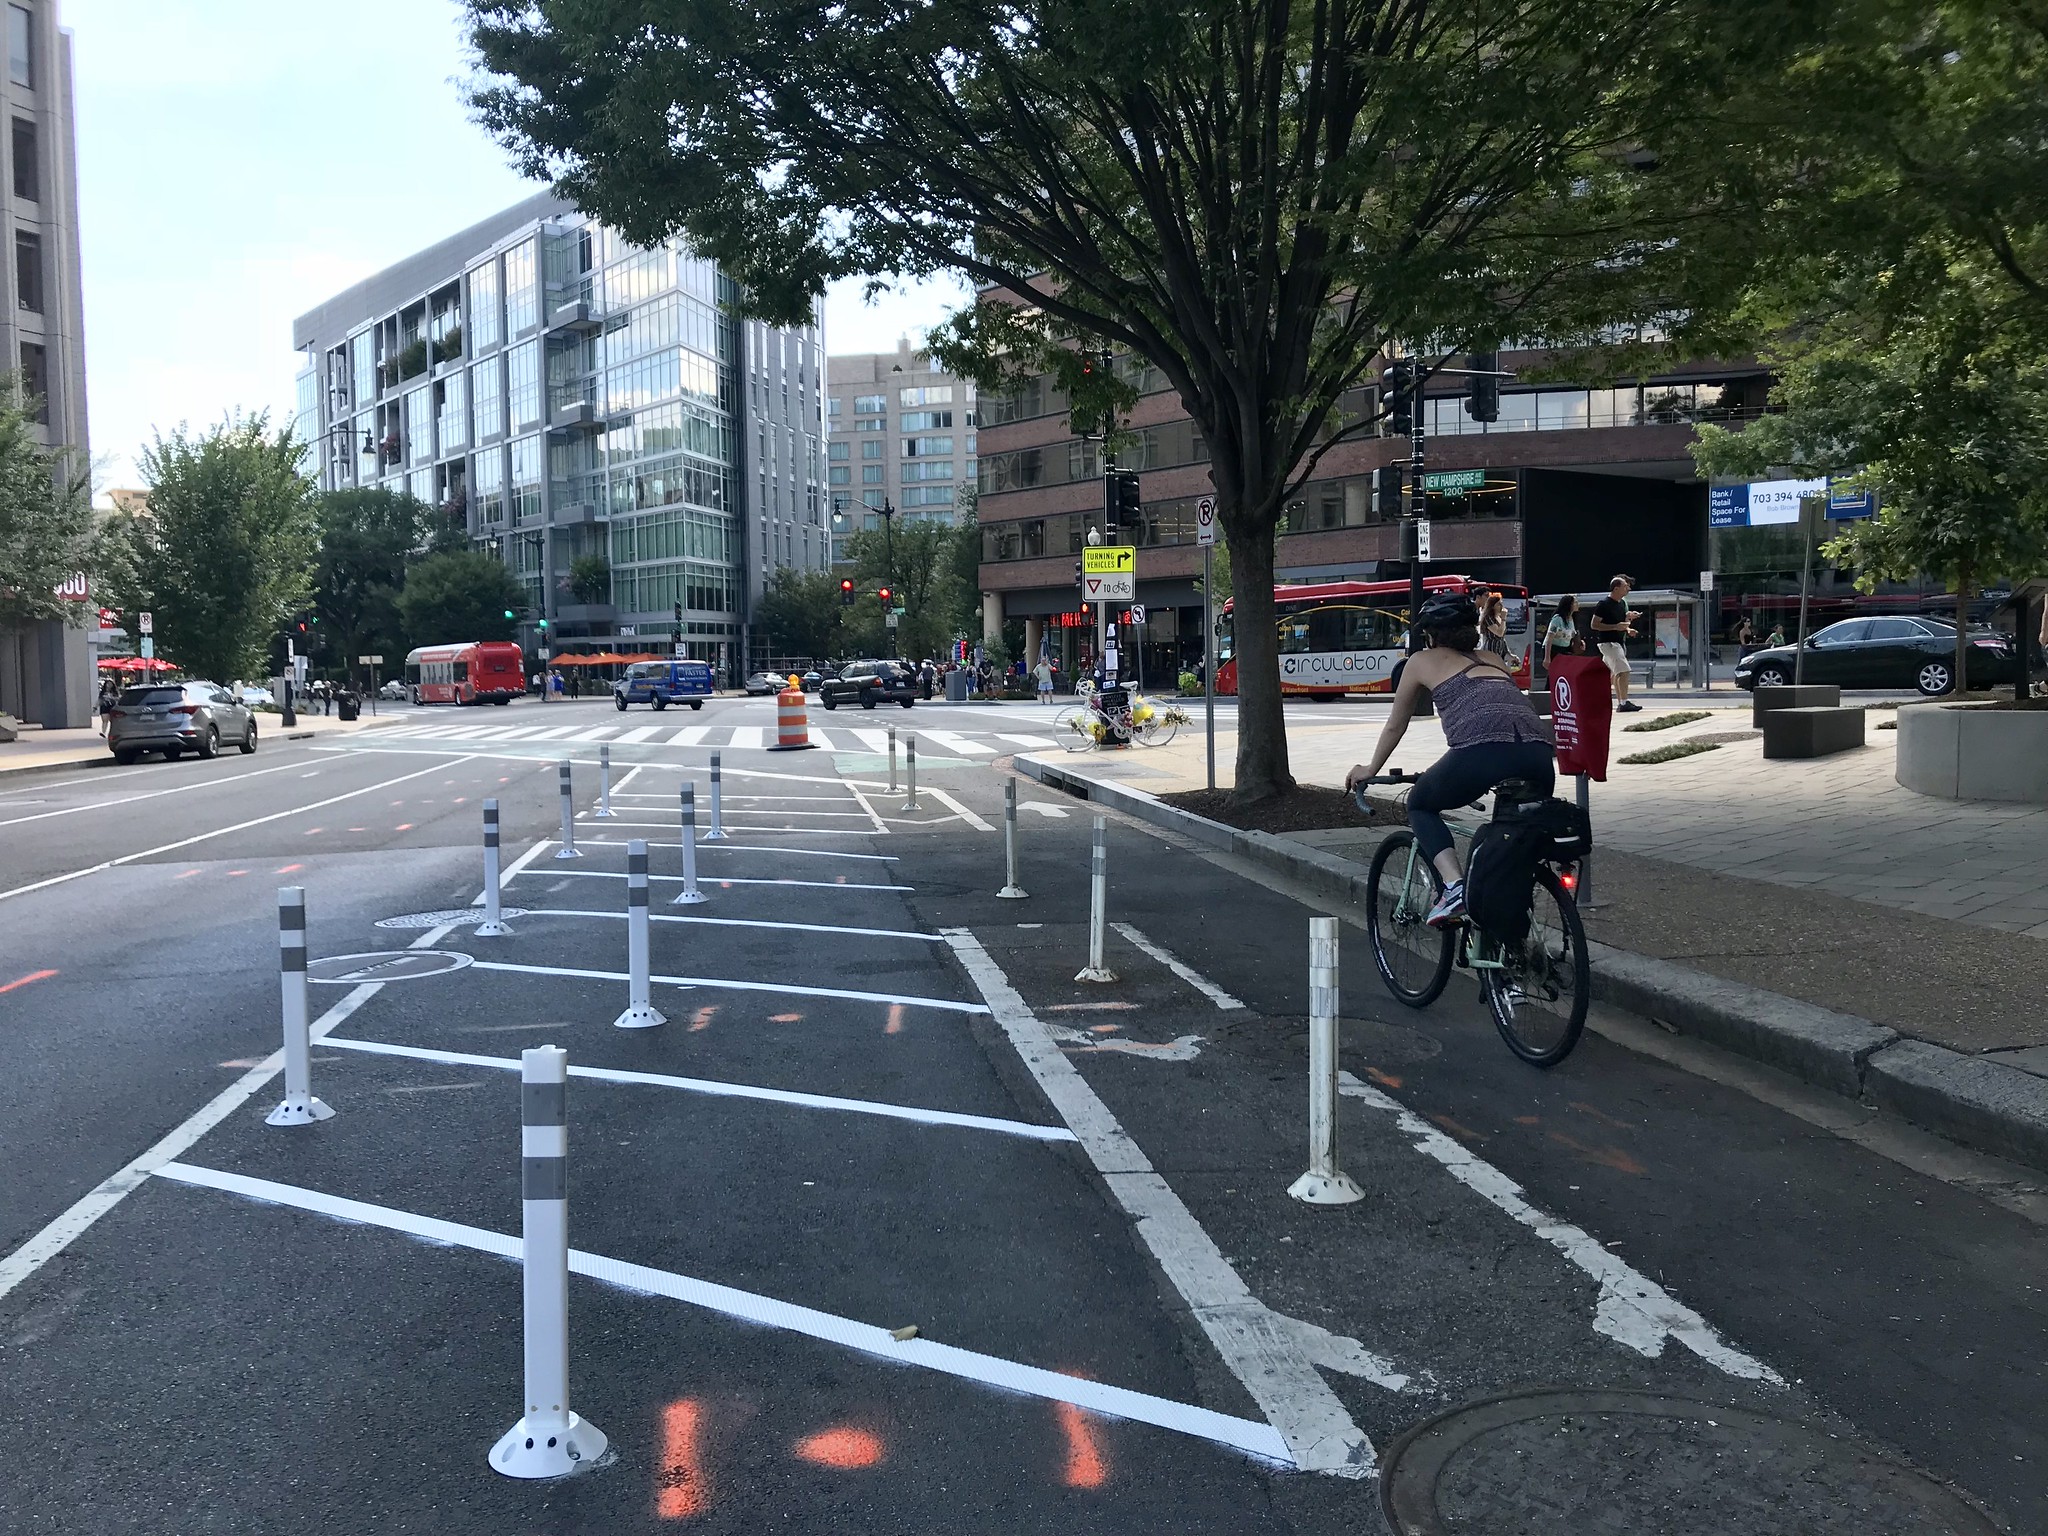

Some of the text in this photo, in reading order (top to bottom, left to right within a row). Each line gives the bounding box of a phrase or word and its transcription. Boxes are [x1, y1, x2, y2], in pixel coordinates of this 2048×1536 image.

[1426, 473, 1474, 488] NEW HAMPSHIRE
[1444, 486, 1463, 497] 1200
[1712, 490, 1729, 498] Bank
[1753, 493, 1771, 504] 703
[1774, 491, 1793, 502] 394
[1712, 499, 1730, 507] Retail
[1711, 507, 1733, 516] Space
[1103, 584, 1111, 593] TO
[1349, 684, 1381, 693] National Mall
